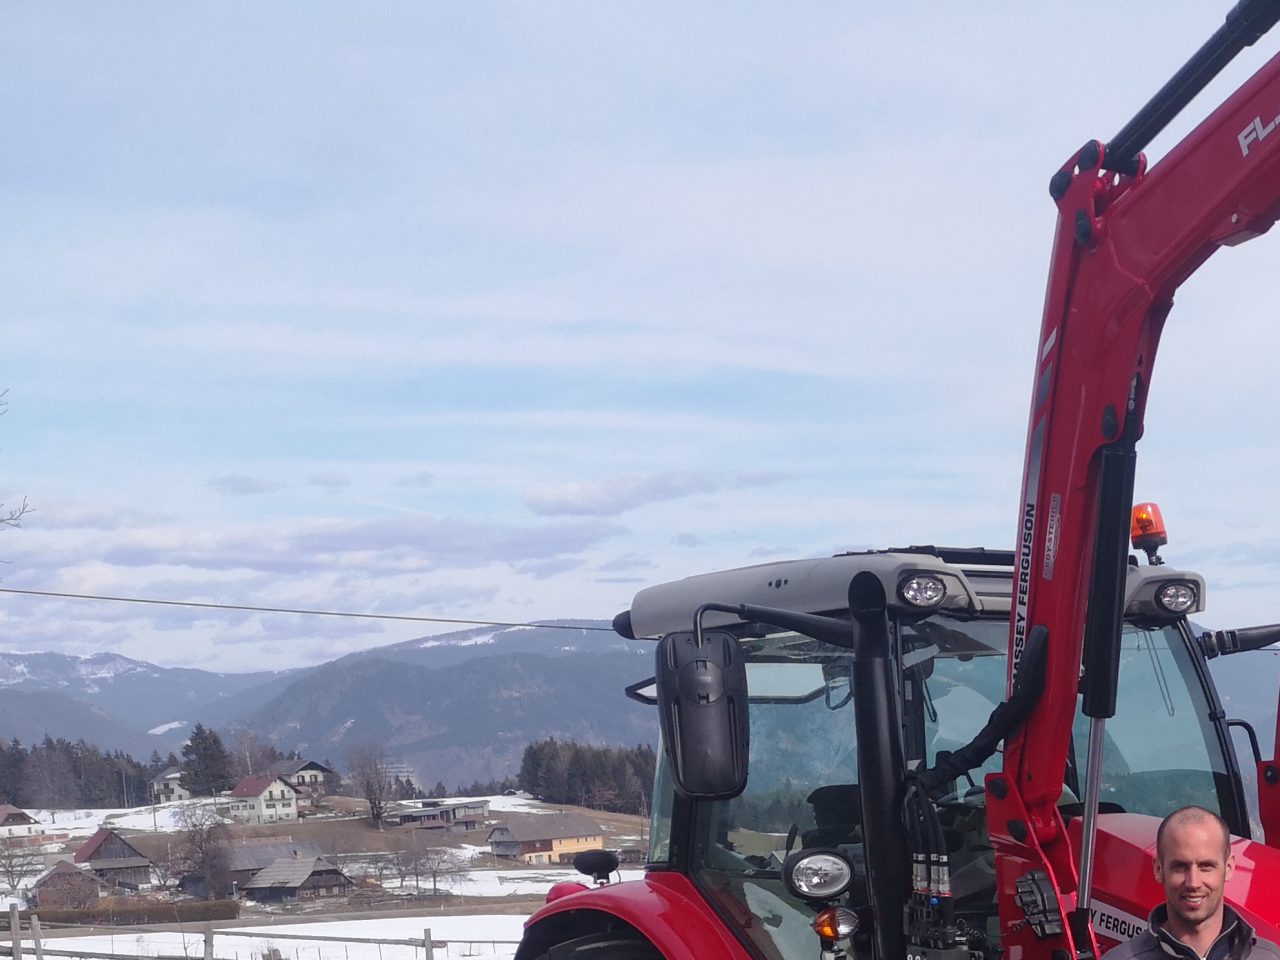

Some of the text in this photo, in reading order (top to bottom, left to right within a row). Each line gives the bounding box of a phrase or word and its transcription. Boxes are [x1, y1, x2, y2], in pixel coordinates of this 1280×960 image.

[1011, 503, 1036, 688] ASSEY FERGUSON
[1099, 912, 1142, 939] FERGUS
